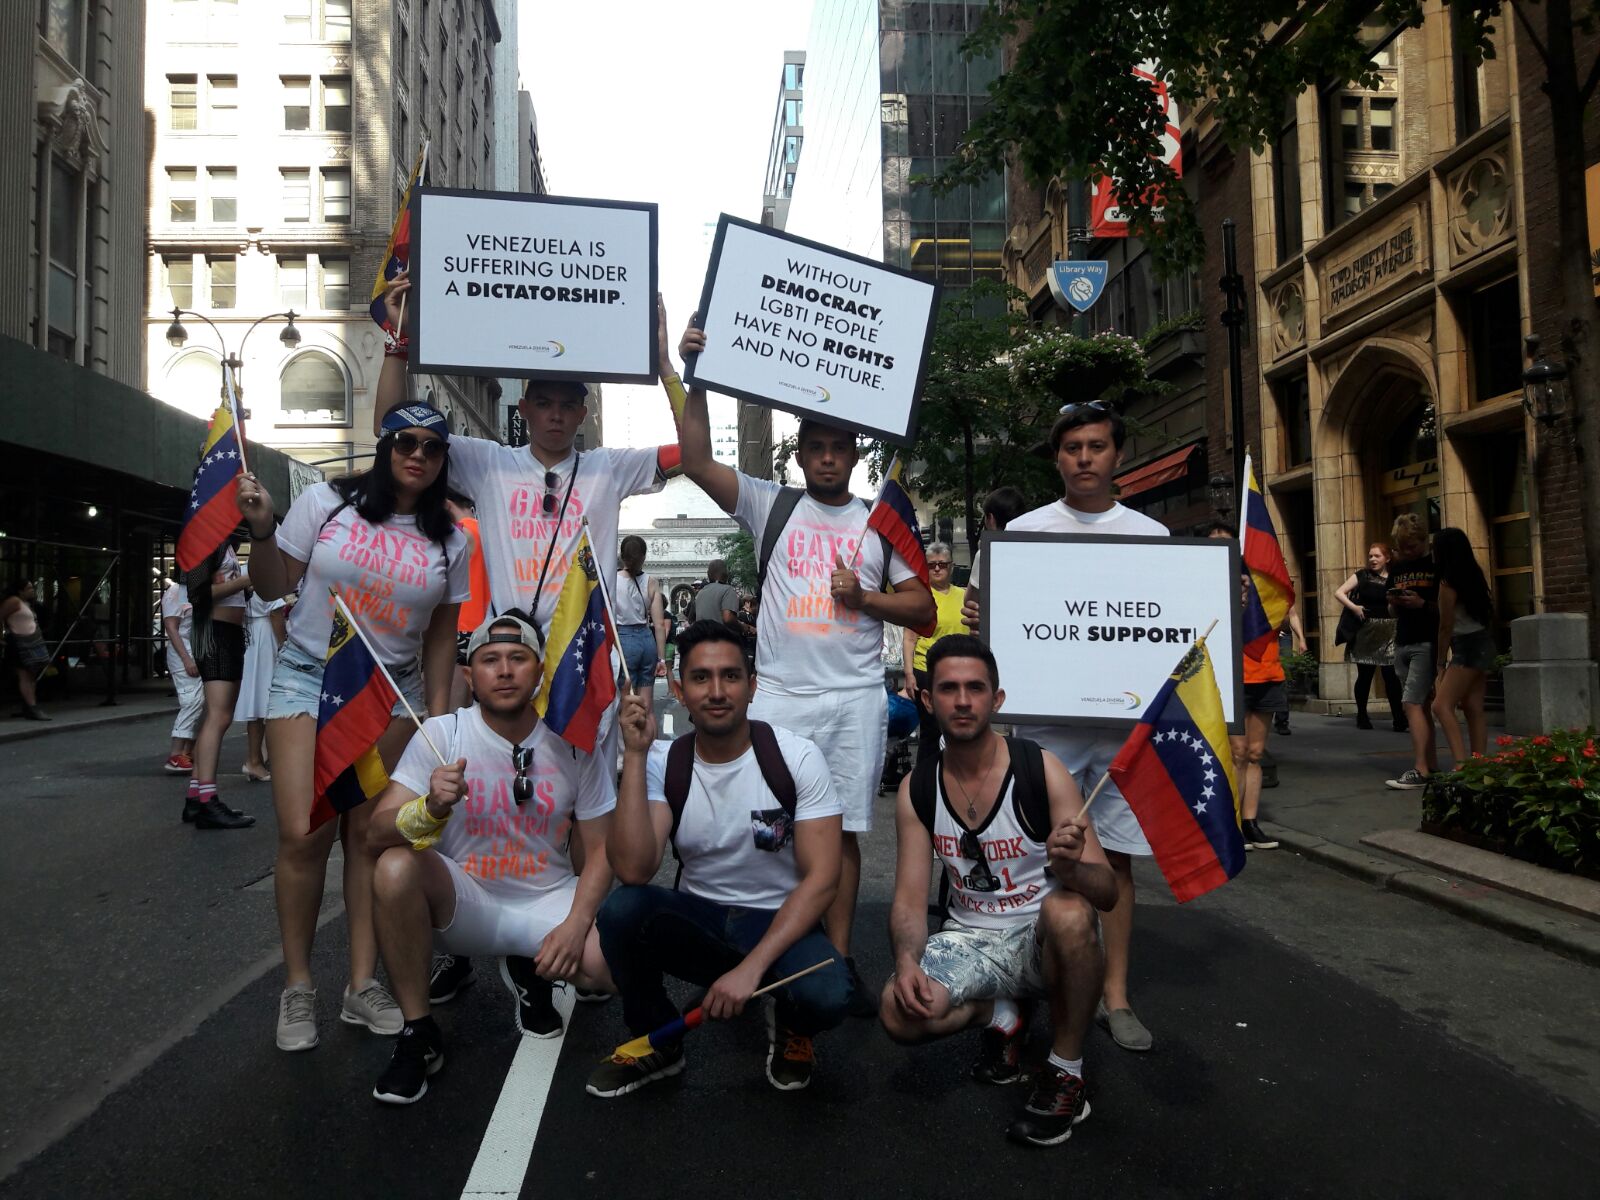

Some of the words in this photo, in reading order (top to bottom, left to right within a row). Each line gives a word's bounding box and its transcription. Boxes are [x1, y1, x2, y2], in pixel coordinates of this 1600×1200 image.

[466, 233, 582, 257] VENEZUELA
[589, 241, 606, 258] IS
[1329, 266, 1351, 289] TWO
[1353, 239, 1388, 279] NINETY
[1389, 226, 1413, 255] NINE
[443, 256, 553, 278] SUFFERING
[561, 263, 628, 282] UNDER
[787, 258, 872, 296] WITHOUT
[1059, 265, 1085, 275] Library
[1087, 265, 1103, 275] Way
[1330, 269, 1371, 310] MADISON
[1374, 244, 1414, 287] AVENUE
[445, 280, 460, 296] A
[467, 281, 626, 306] DICTATORSHIP.
[761, 274, 884, 326] DEMOCRACY,
[760, 295, 809, 323] LGBTI
[814, 312, 879, 344] PEOPLE
[734, 311, 783, 338] HAVE
[787, 326, 818, 347] NO
[822, 338, 895, 370] RIGHTS
[731, 335, 774, 357] AND
[779, 347, 810, 368] NO
[815, 358, 886, 391] FUTURE.
[511, 408, 523, 448] ANNI
[348, 522, 430, 568] GAYS
[787, 529, 864, 567] GAYS
[338, 543, 428, 592] CONTRA
[514, 556, 574, 581] ARMA
[787, 558, 862, 580] CONT
[358, 573, 396, 599] LAS
[808, 578, 832, 597] LA
[1064, 600, 1098, 617] WE
[1106, 601, 1162, 618] NEED
[1022, 623, 1080, 641] YOUR
[1087, 625, 1197, 644] SUPPORT!
[464, 815, 549, 837] CONTRA
[491, 838, 526, 855] LAS
[464, 851, 549, 881] ARMAS
[997, 883, 1042, 913] FIELD
